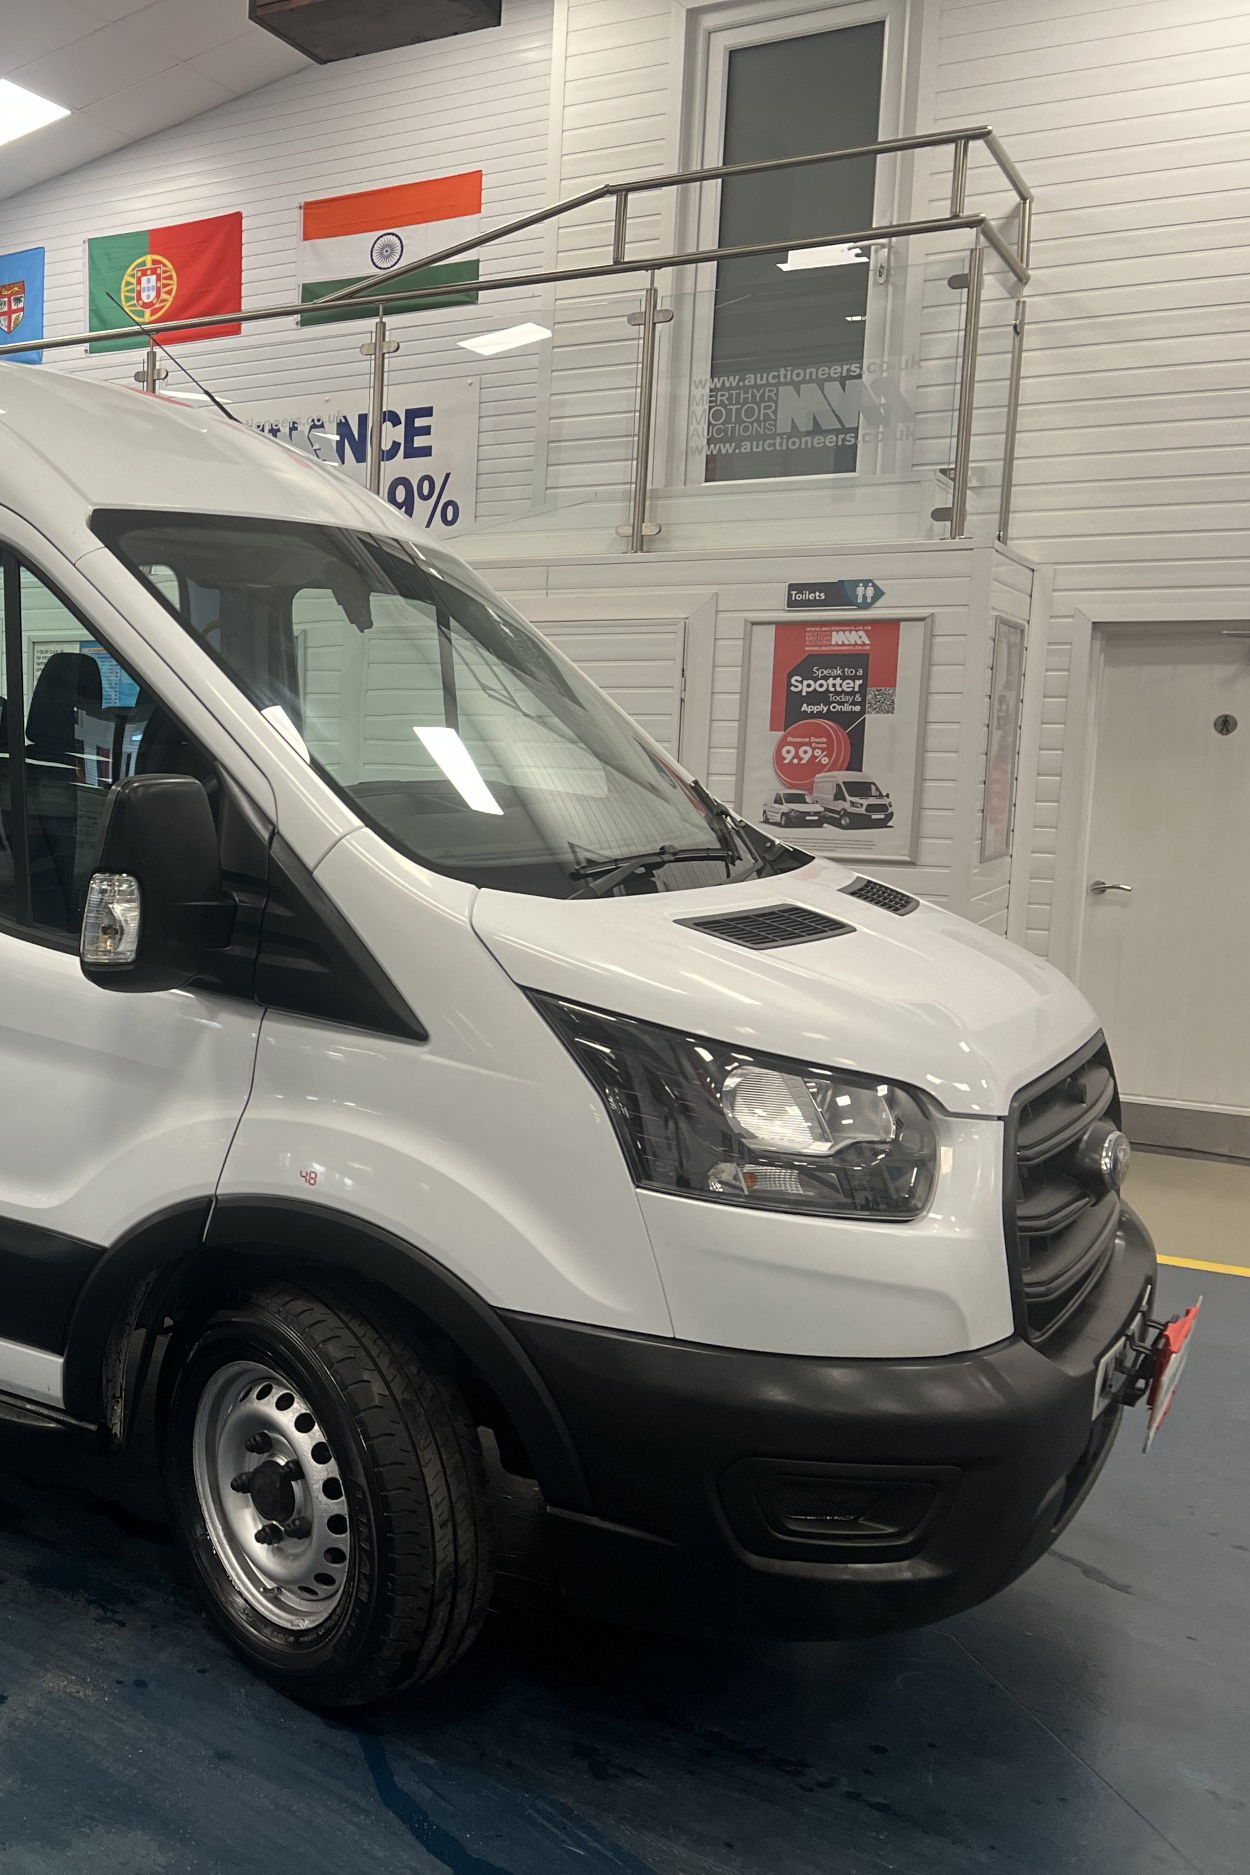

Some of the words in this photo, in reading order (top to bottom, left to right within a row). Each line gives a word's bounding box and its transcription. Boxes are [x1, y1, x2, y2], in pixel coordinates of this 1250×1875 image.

[692, 387, 777, 408] MERTHYR
[690, 403, 776, 426] MOTOR
[690, 421, 776, 440] AUCTIONS
[790, 590, 826, 601] Toilets
[812, 666, 843, 678] Speak
[844, 667, 855, 676] to
[790, 675, 863, 696] Spotter
[828, 693, 854, 703] Today
[854, 693, 862, 702] &
[800, 703, 829, 714] Apply
[829, 702, 861, 712] Online
[781, 745, 829, 765] 9.9%
